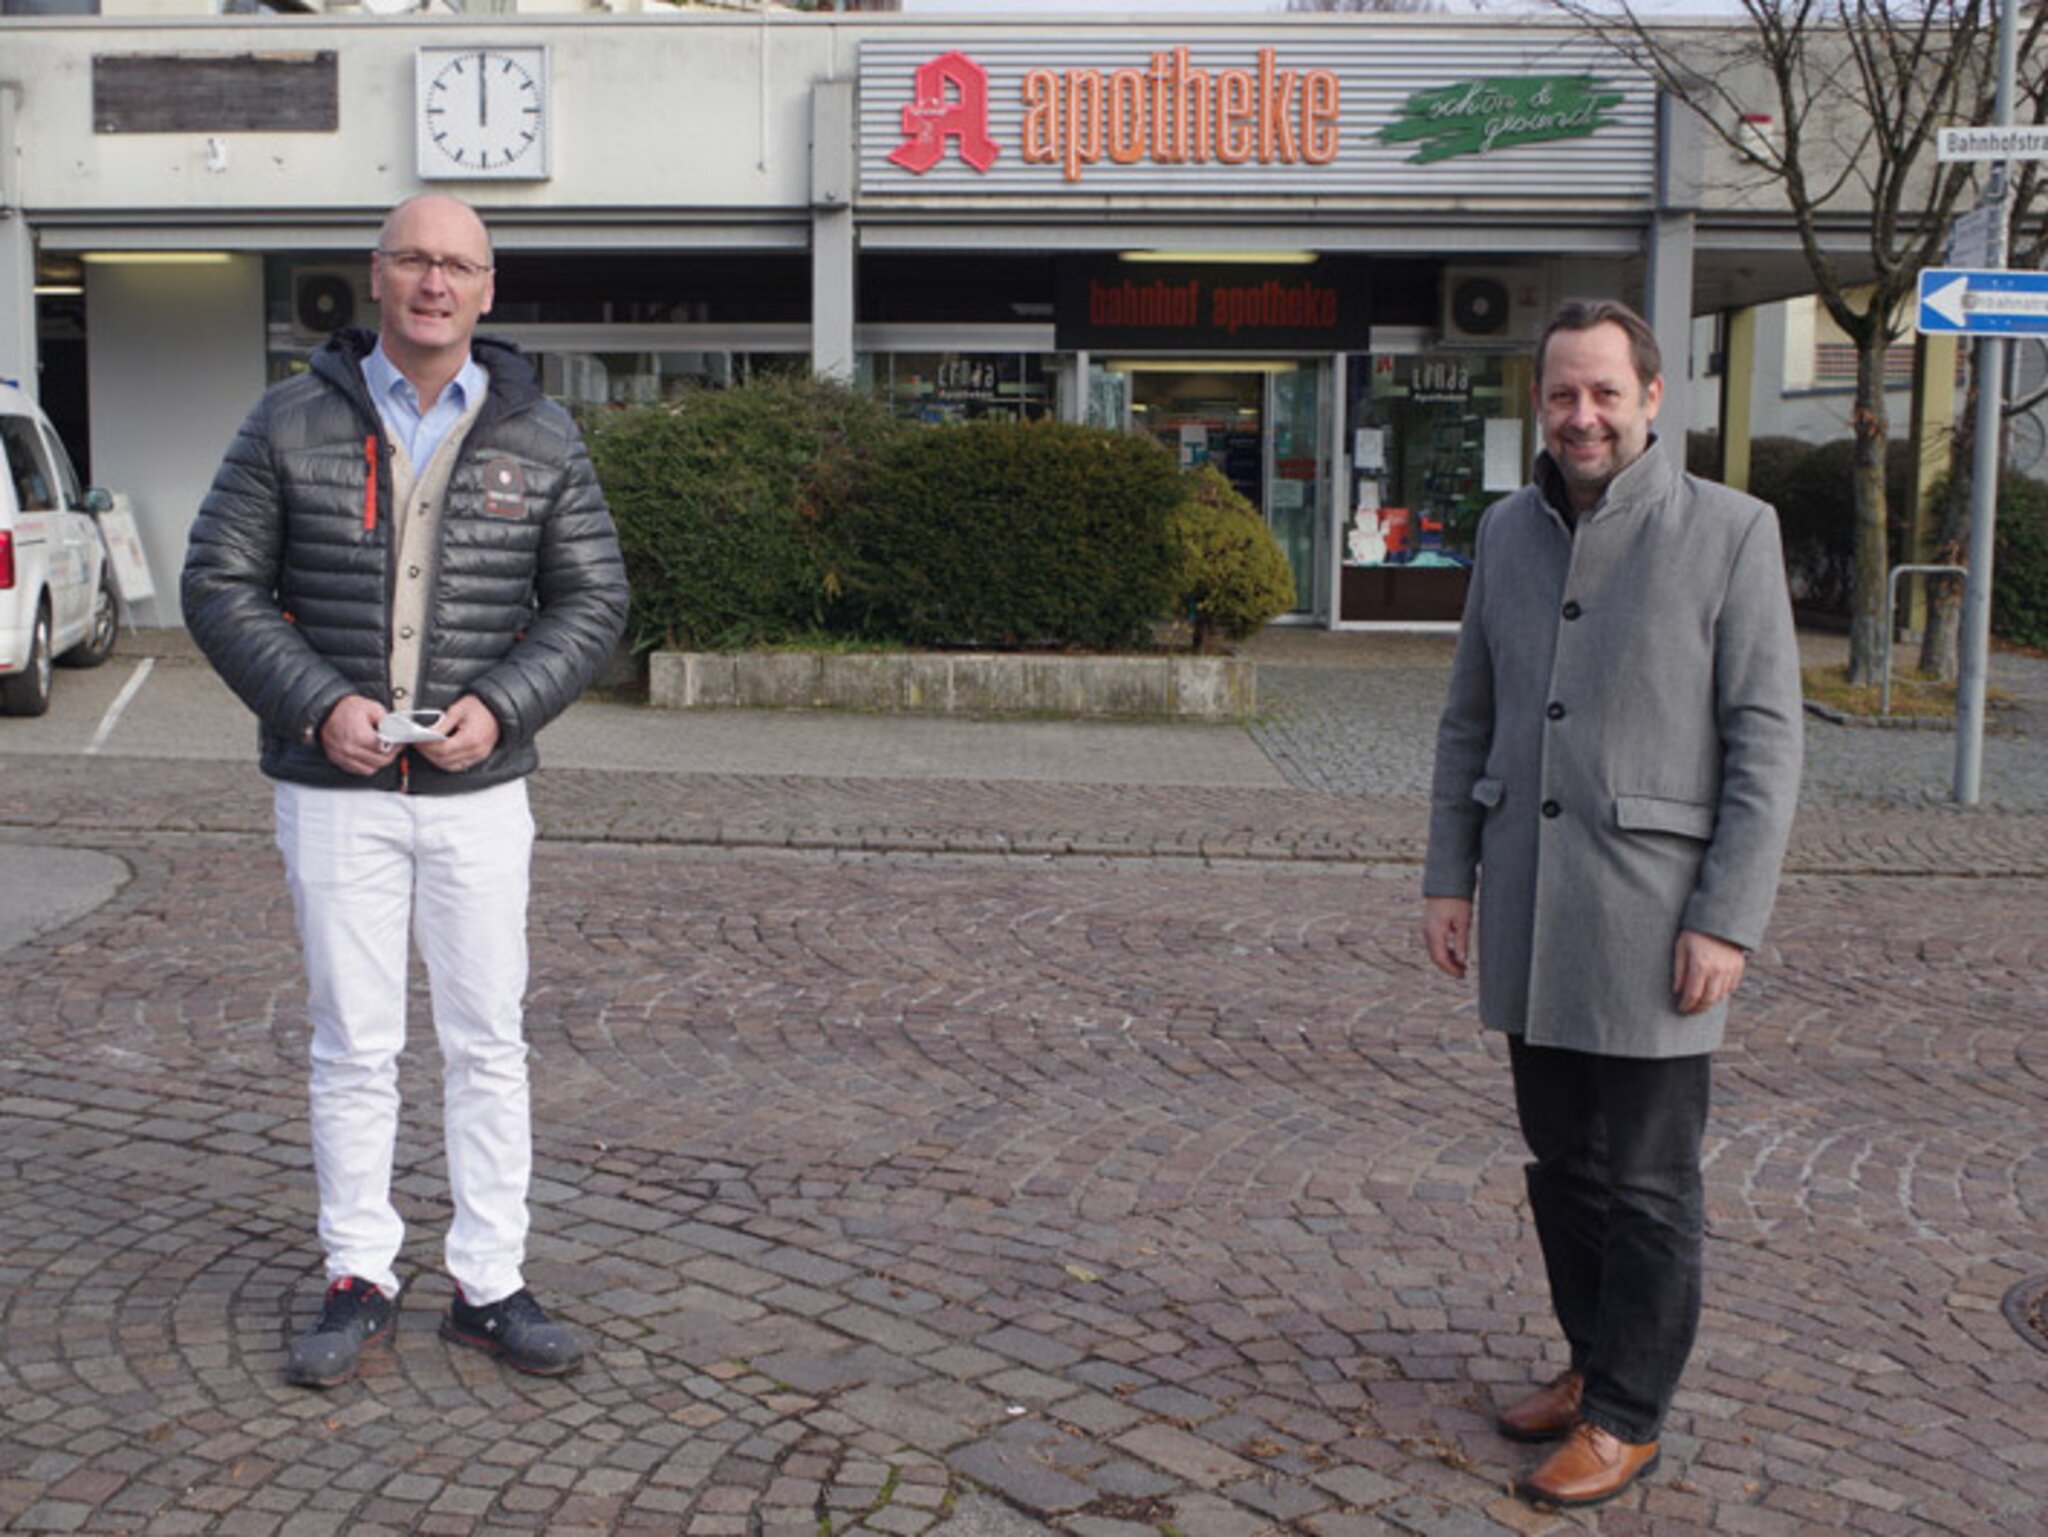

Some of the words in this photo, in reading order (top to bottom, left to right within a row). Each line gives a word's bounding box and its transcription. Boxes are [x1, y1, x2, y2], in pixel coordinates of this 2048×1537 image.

[1021, 46, 1340, 182] apotheke
[1088, 277, 1200, 327] bahnhof
[1211, 279, 1338, 334] apotheke
